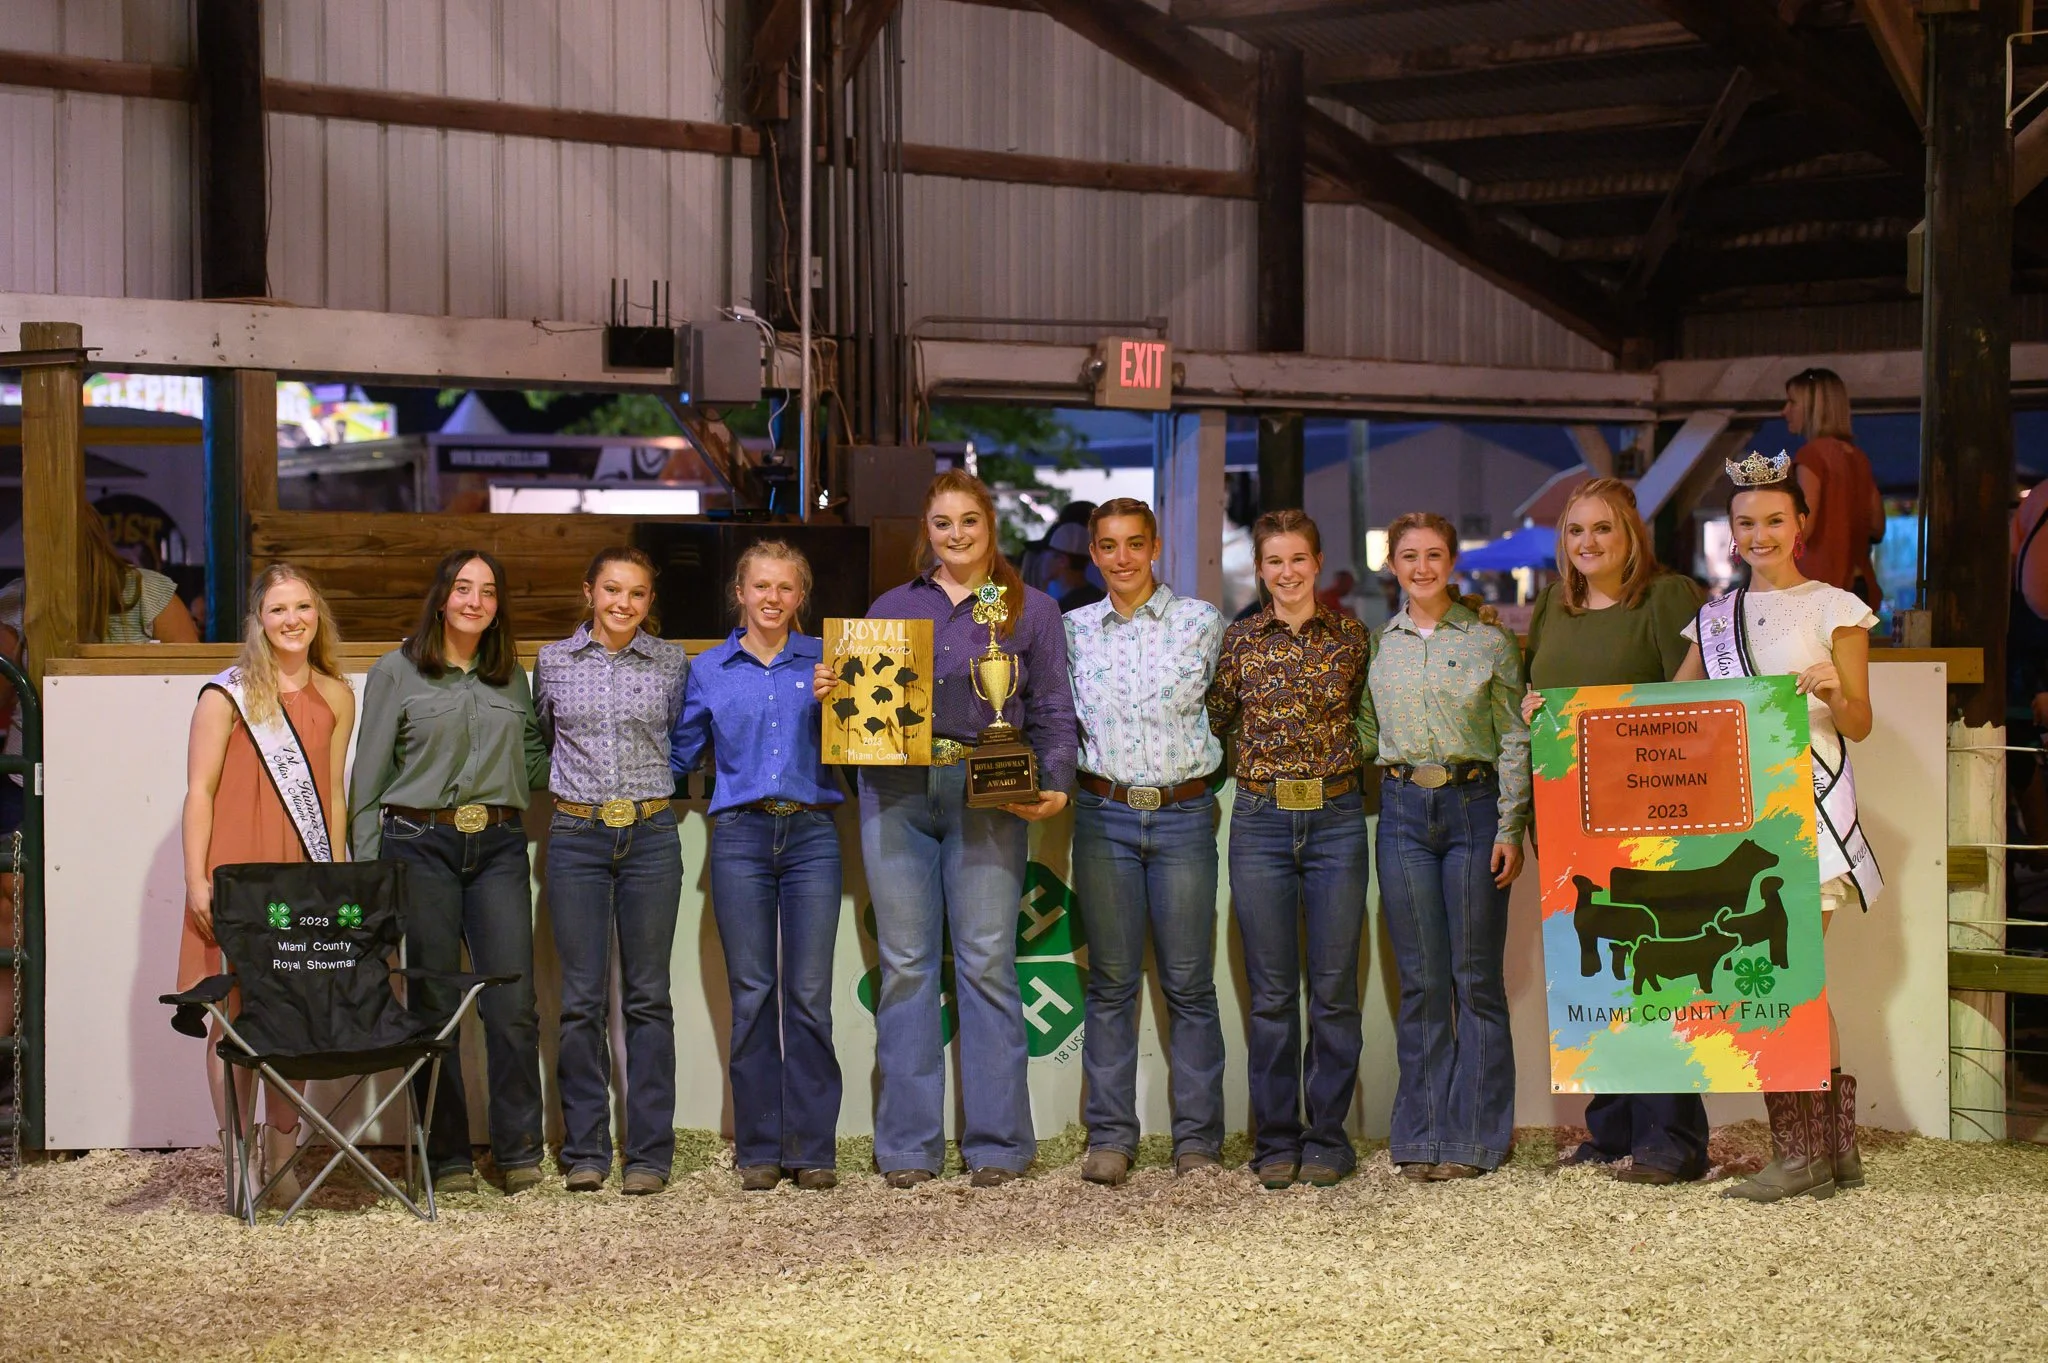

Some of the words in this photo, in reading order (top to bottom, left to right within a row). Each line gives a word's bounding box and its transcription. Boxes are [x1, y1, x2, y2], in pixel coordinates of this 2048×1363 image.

[1121, 341, 1165, 389] EXIT
[91, 374, 203, 420] ELEPHA
[842, 619, 909, 641] ROYAL
[835, 638, 911, 656] Showman
[1715, 642, 1734, 676] Miss
[1616, 721, 1698, 737] CHAMPION
[863, 736, 883, 746] 2023
[845, 749, 873, 761] Miami
[876, 748, 908, 764] County
[1636, 747, 1687, 762] ROYAL
[974, 762, 993, 771] ROYAL
[994, 760, 1025, 770] SHOWMAN
[273, 754, 289, 779] Miss
[287, 787, 307, 822] Miami
[987, 778, 1017, 787] AWARD
[1626, 773, 1708, 789] SHOWMAN
[1648, 804, 1688, 819] 2023
[299, 916, 330, 927] 2023
[278, 941, 307, 952] Miami
[312, 940, 352, 953] County
[273, 959, 301, 971] Royal
[306, 959, 356, 970] Showman
[1567, 1004, 1632, 1022] MIAMI
[1642, 1004, 1730, 1022] COUNTY
[1740, 1001, 1791, 1019] FAIR
[1054, 1050, 1070, 1064] 18
